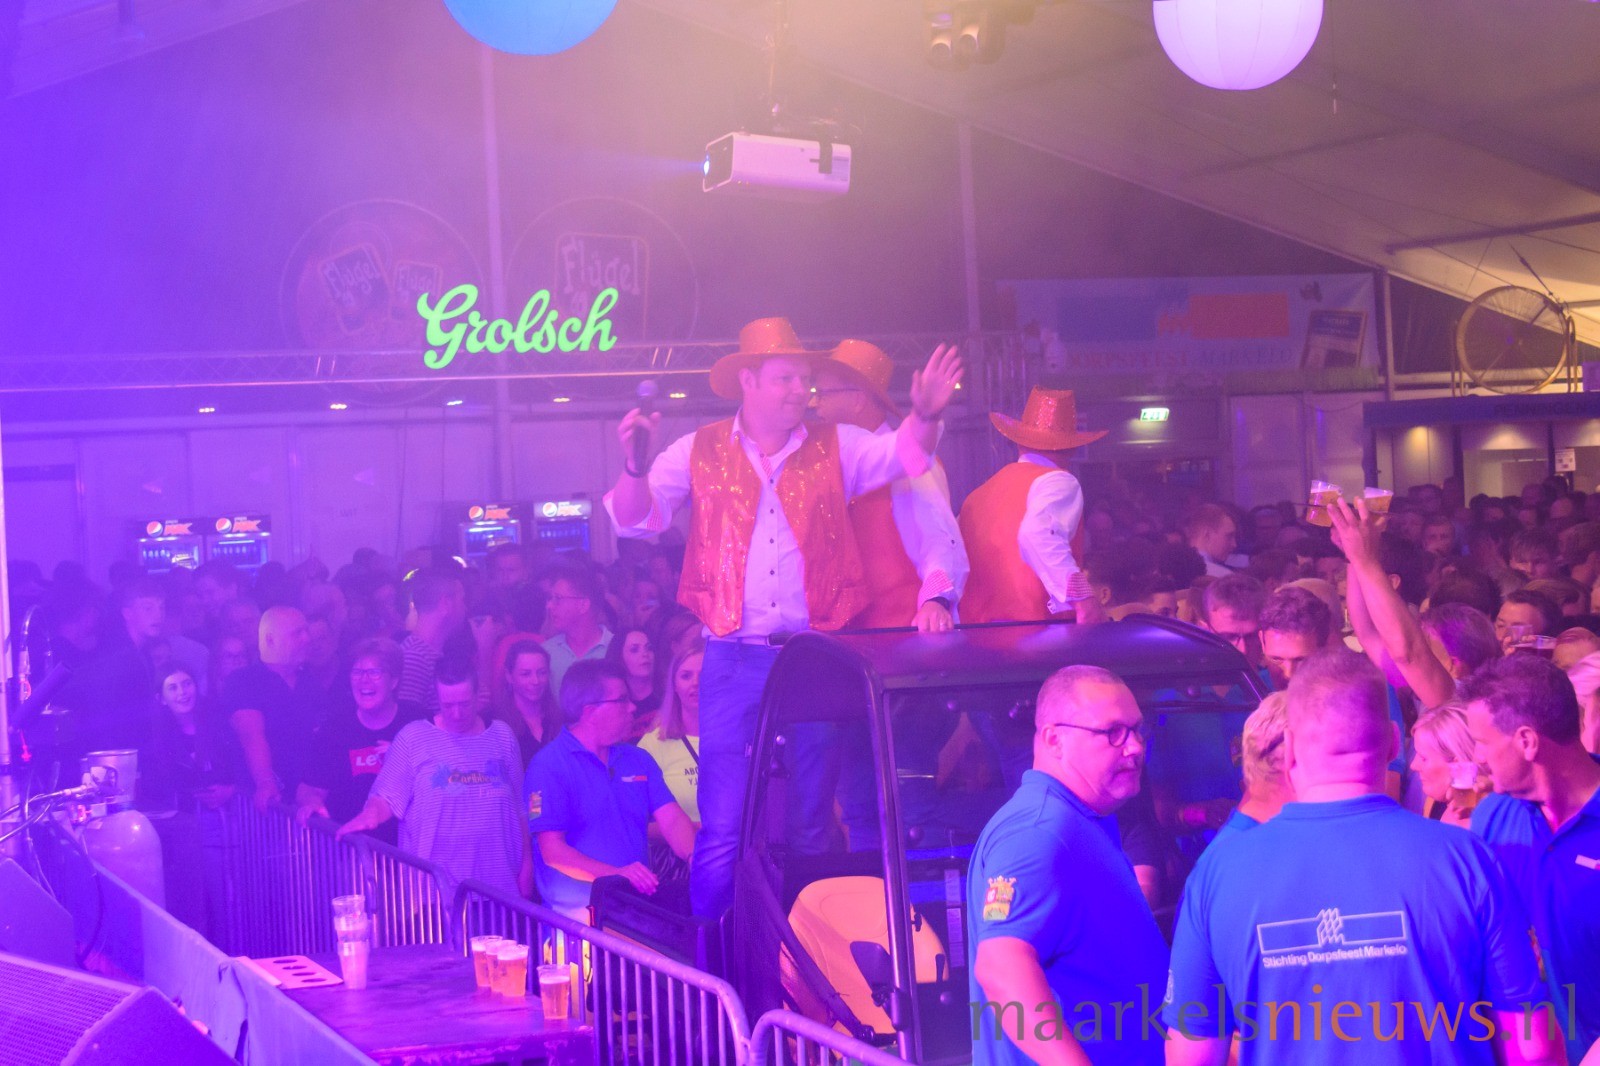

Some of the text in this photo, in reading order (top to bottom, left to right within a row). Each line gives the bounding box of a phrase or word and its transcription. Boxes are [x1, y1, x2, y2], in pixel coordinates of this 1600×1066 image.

[416, 283, 619, 369] Grolsch
[1262, 944, 1408, 969] Stichting Dorpsfeest Markelo
